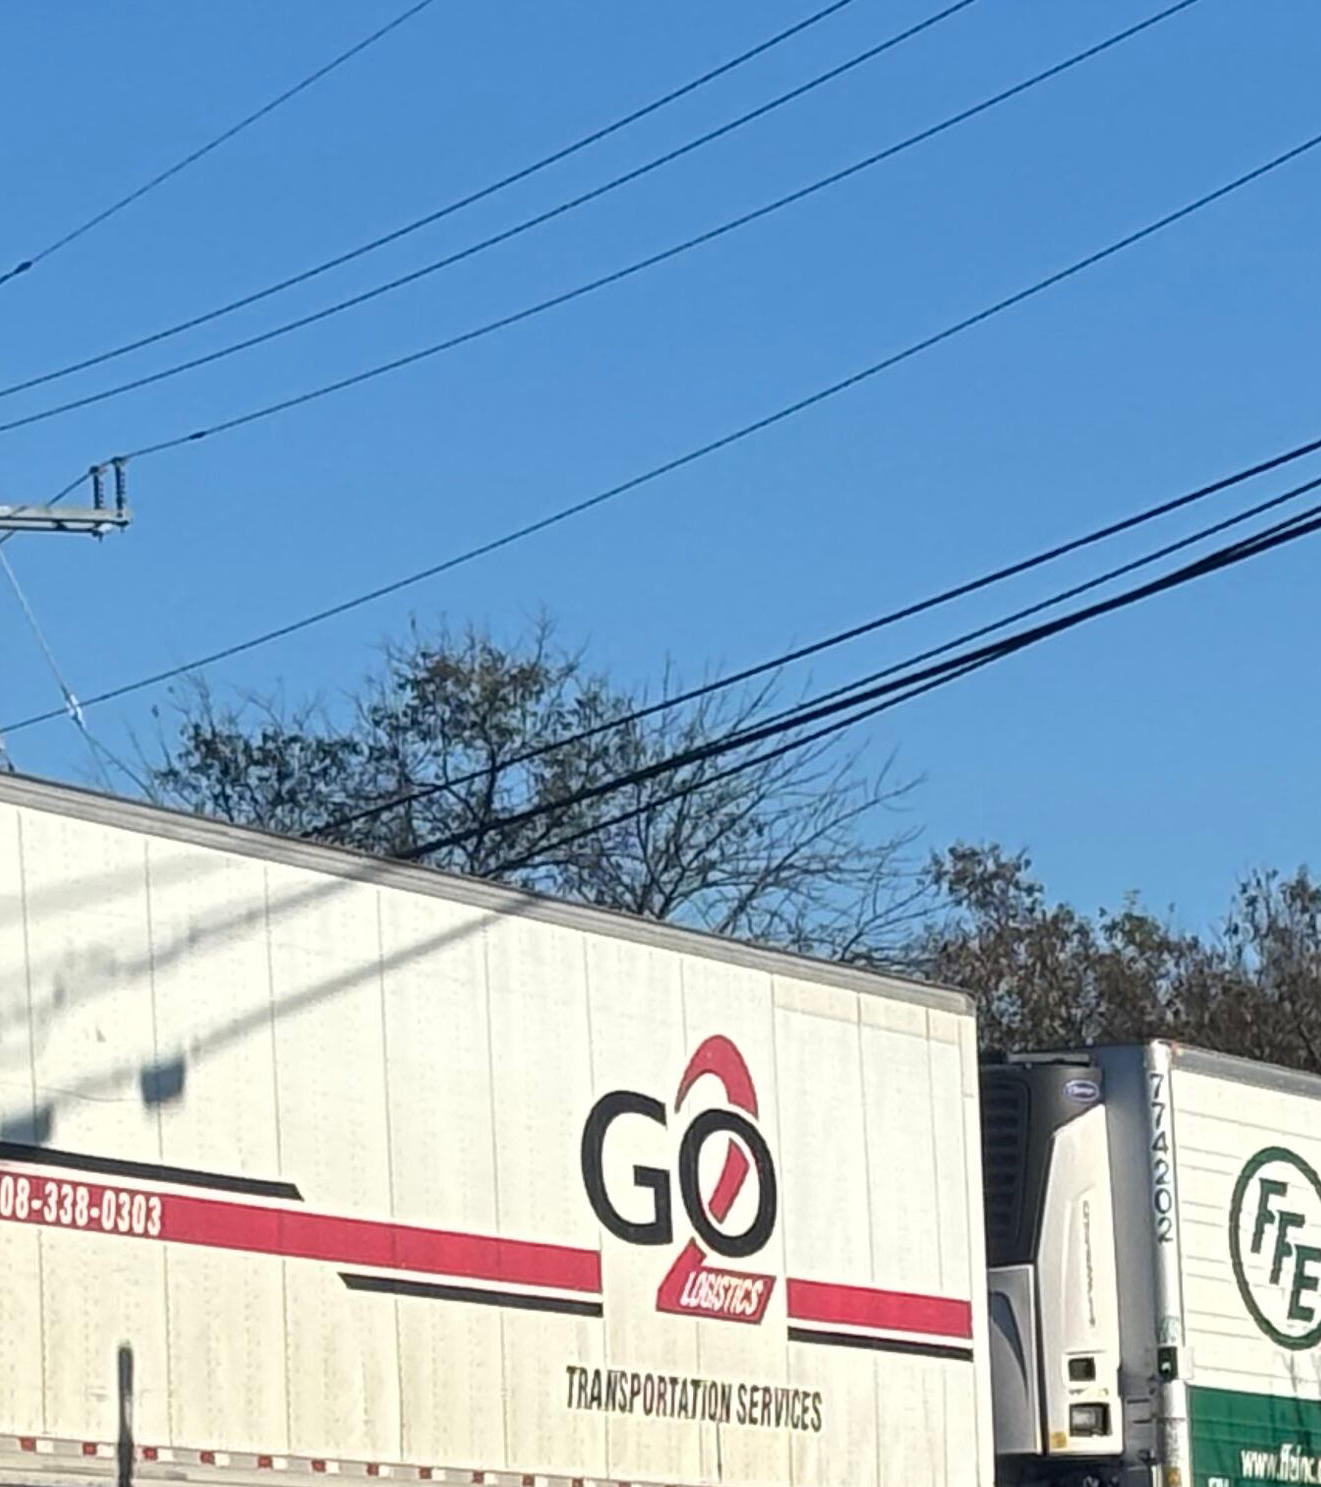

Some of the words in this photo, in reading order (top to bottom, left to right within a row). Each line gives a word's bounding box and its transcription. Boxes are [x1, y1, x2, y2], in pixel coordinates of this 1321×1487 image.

[1148, 1072, 1174, 1244] 774202
[680, 1269, 764, 1316] LOGISTICS
[565, 1364, 734, 1424] TRANSPORTATION
[735, 1380, 823, 1433] SERVICES
